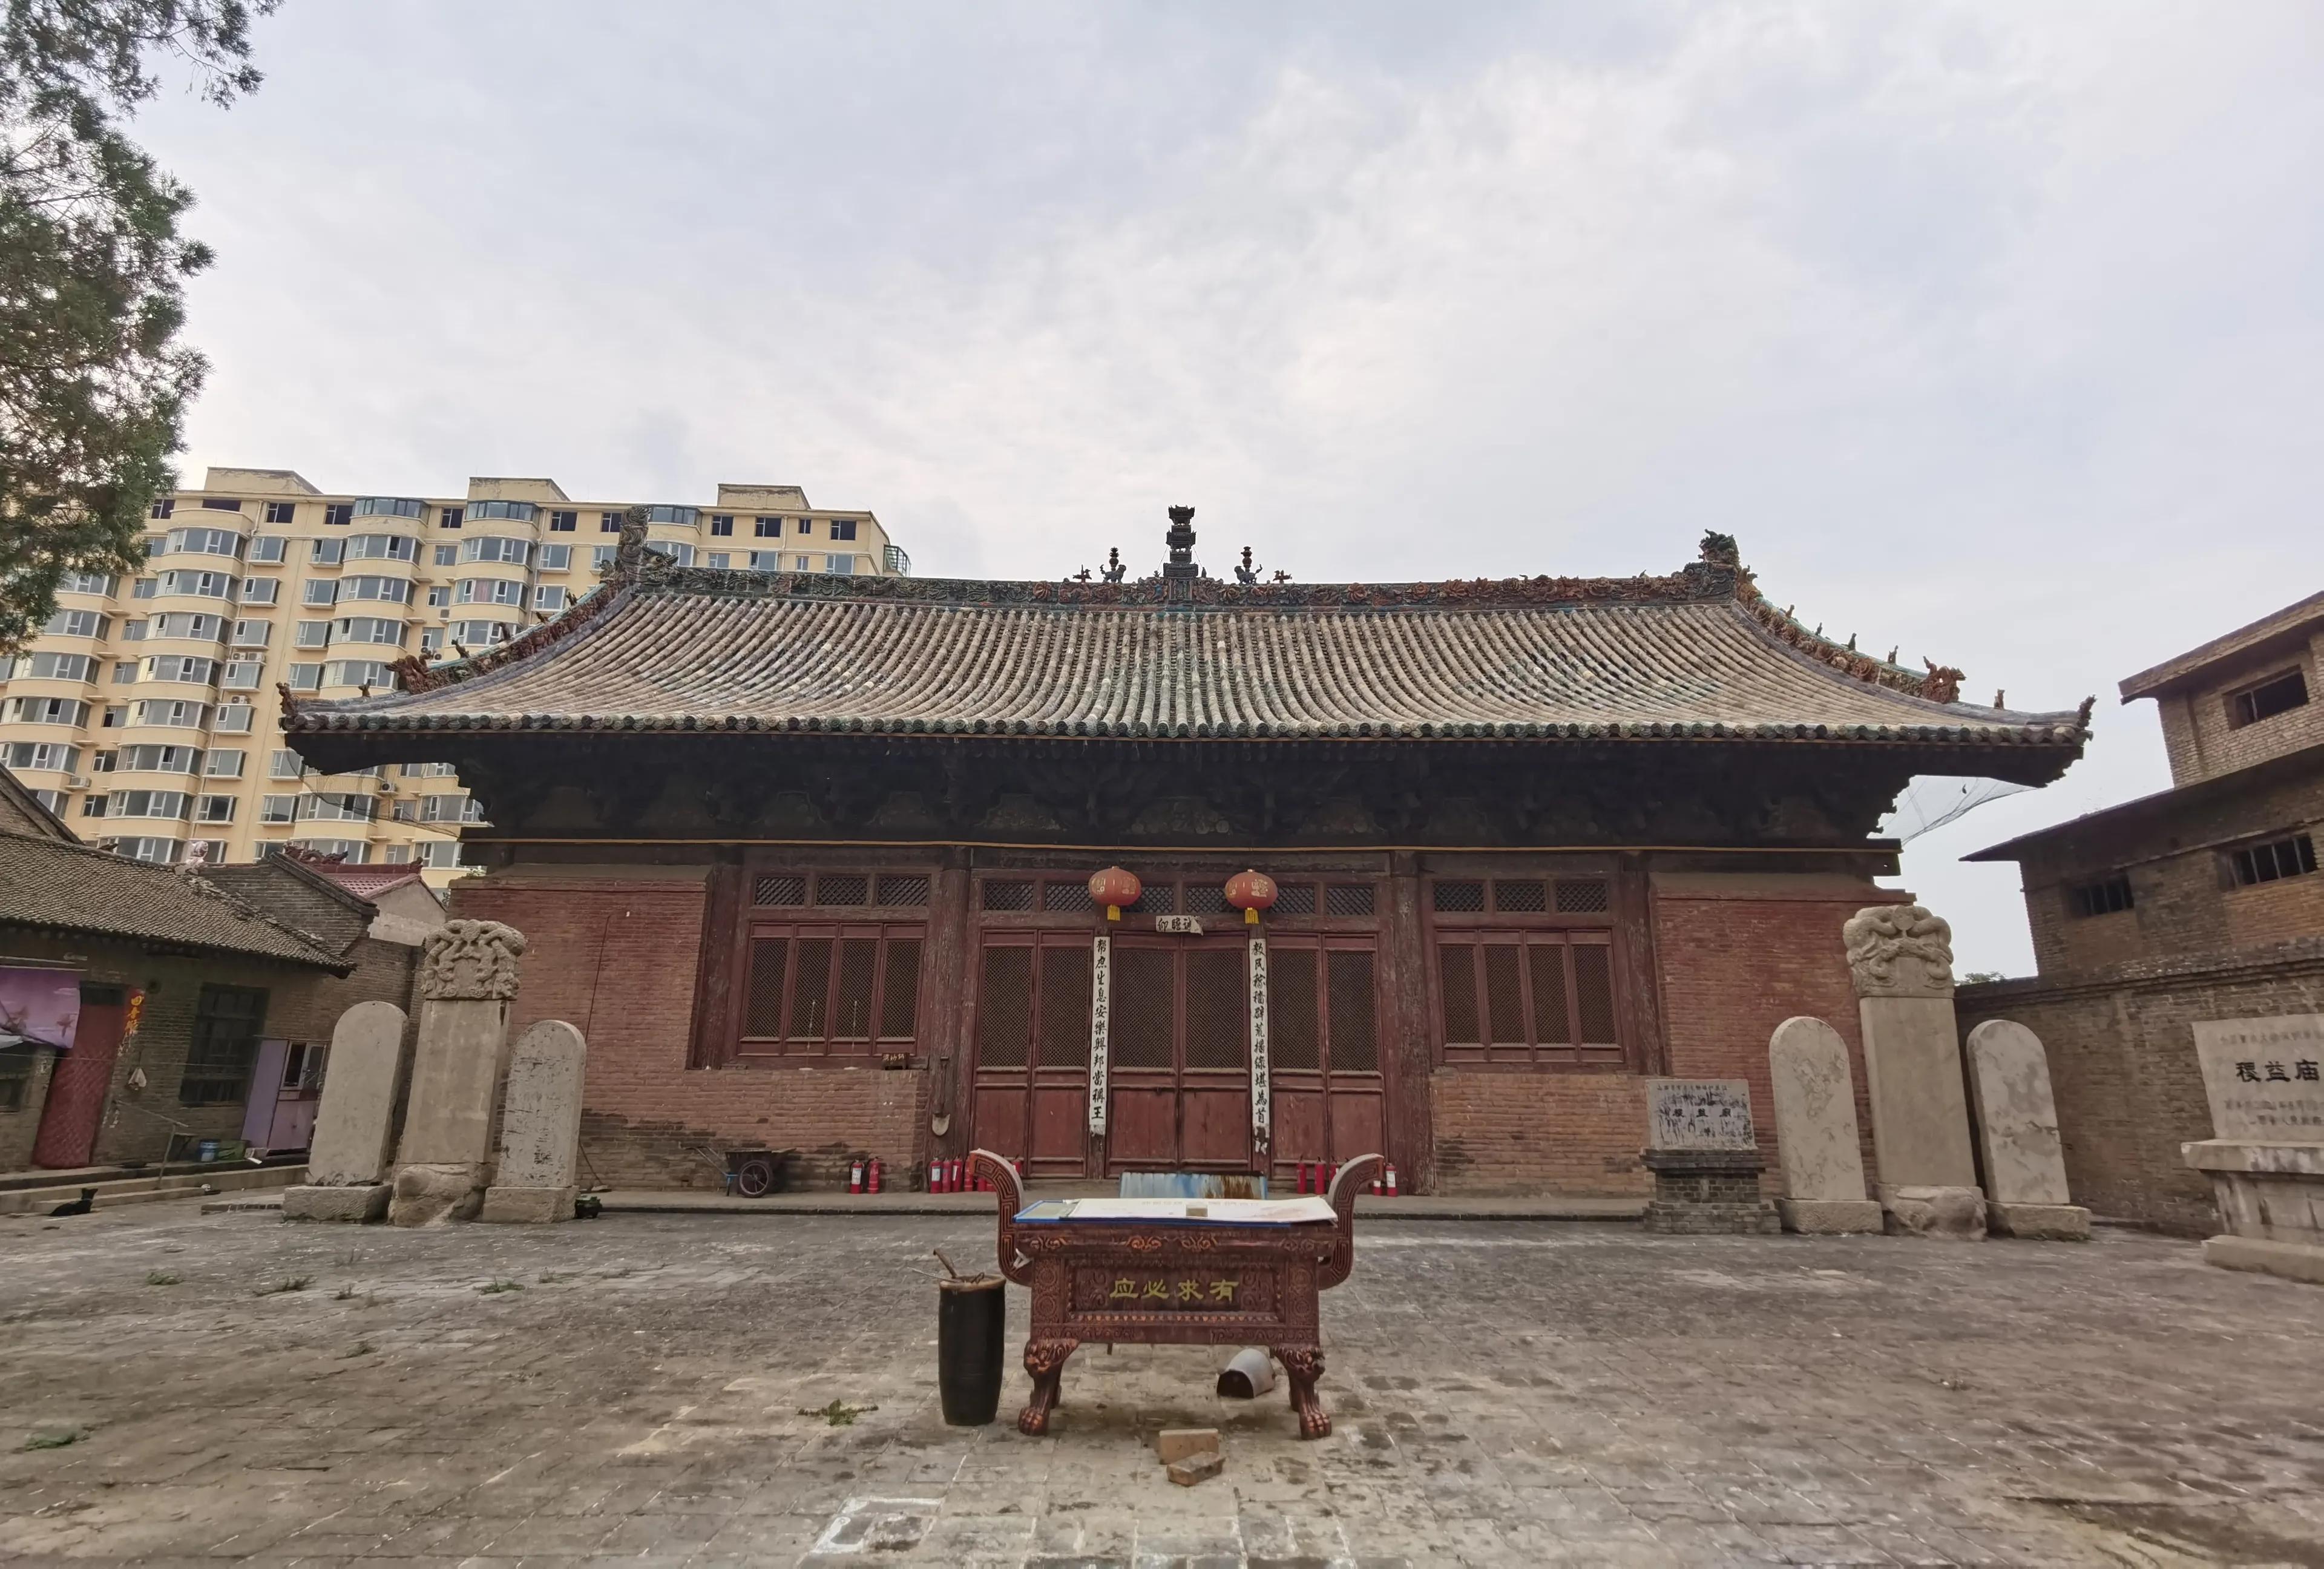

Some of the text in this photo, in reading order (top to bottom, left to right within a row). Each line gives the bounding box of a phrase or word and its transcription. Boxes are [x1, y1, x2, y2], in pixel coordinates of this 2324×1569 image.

[2235, 1059, 2320, 1082] 稷益庙
[1109, 1277, 1239, 1303] 有求必应
